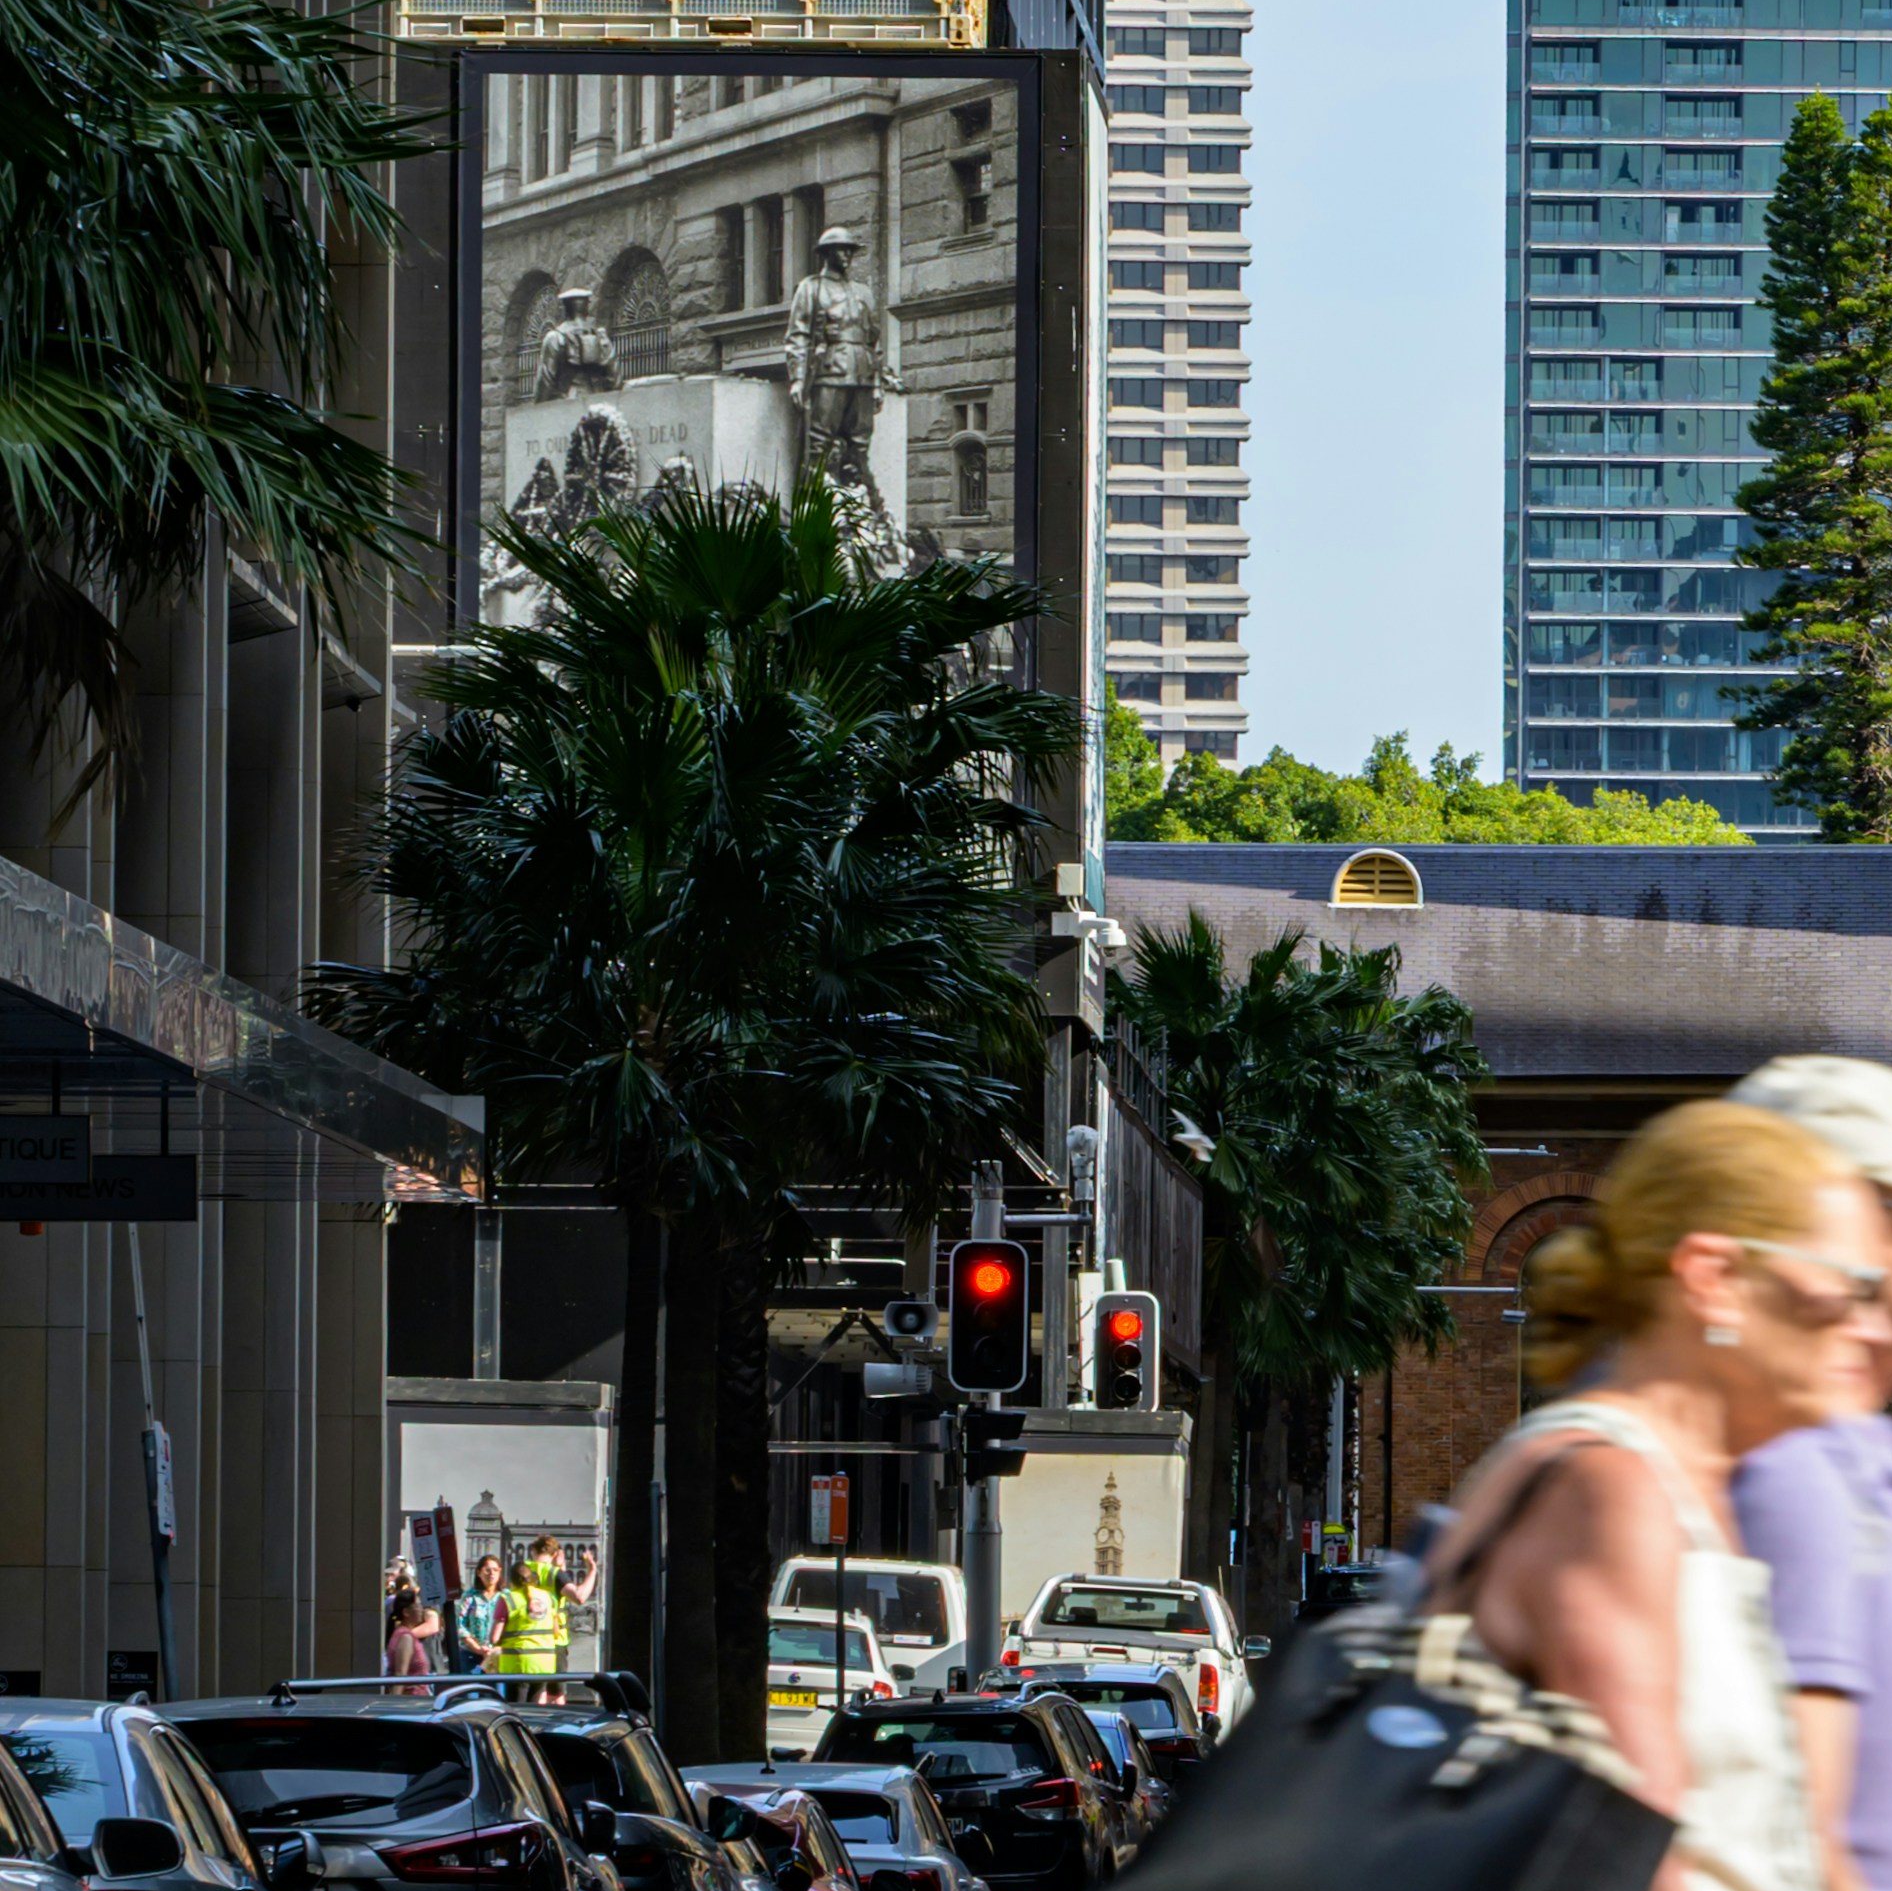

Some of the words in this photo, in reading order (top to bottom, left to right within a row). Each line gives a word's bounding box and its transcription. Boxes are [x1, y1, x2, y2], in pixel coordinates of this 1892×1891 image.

[526, 439, 540, 457] TO
[649, 422, 689, 446] DEAD
[56, 1177, 136, 1199] NEWS
